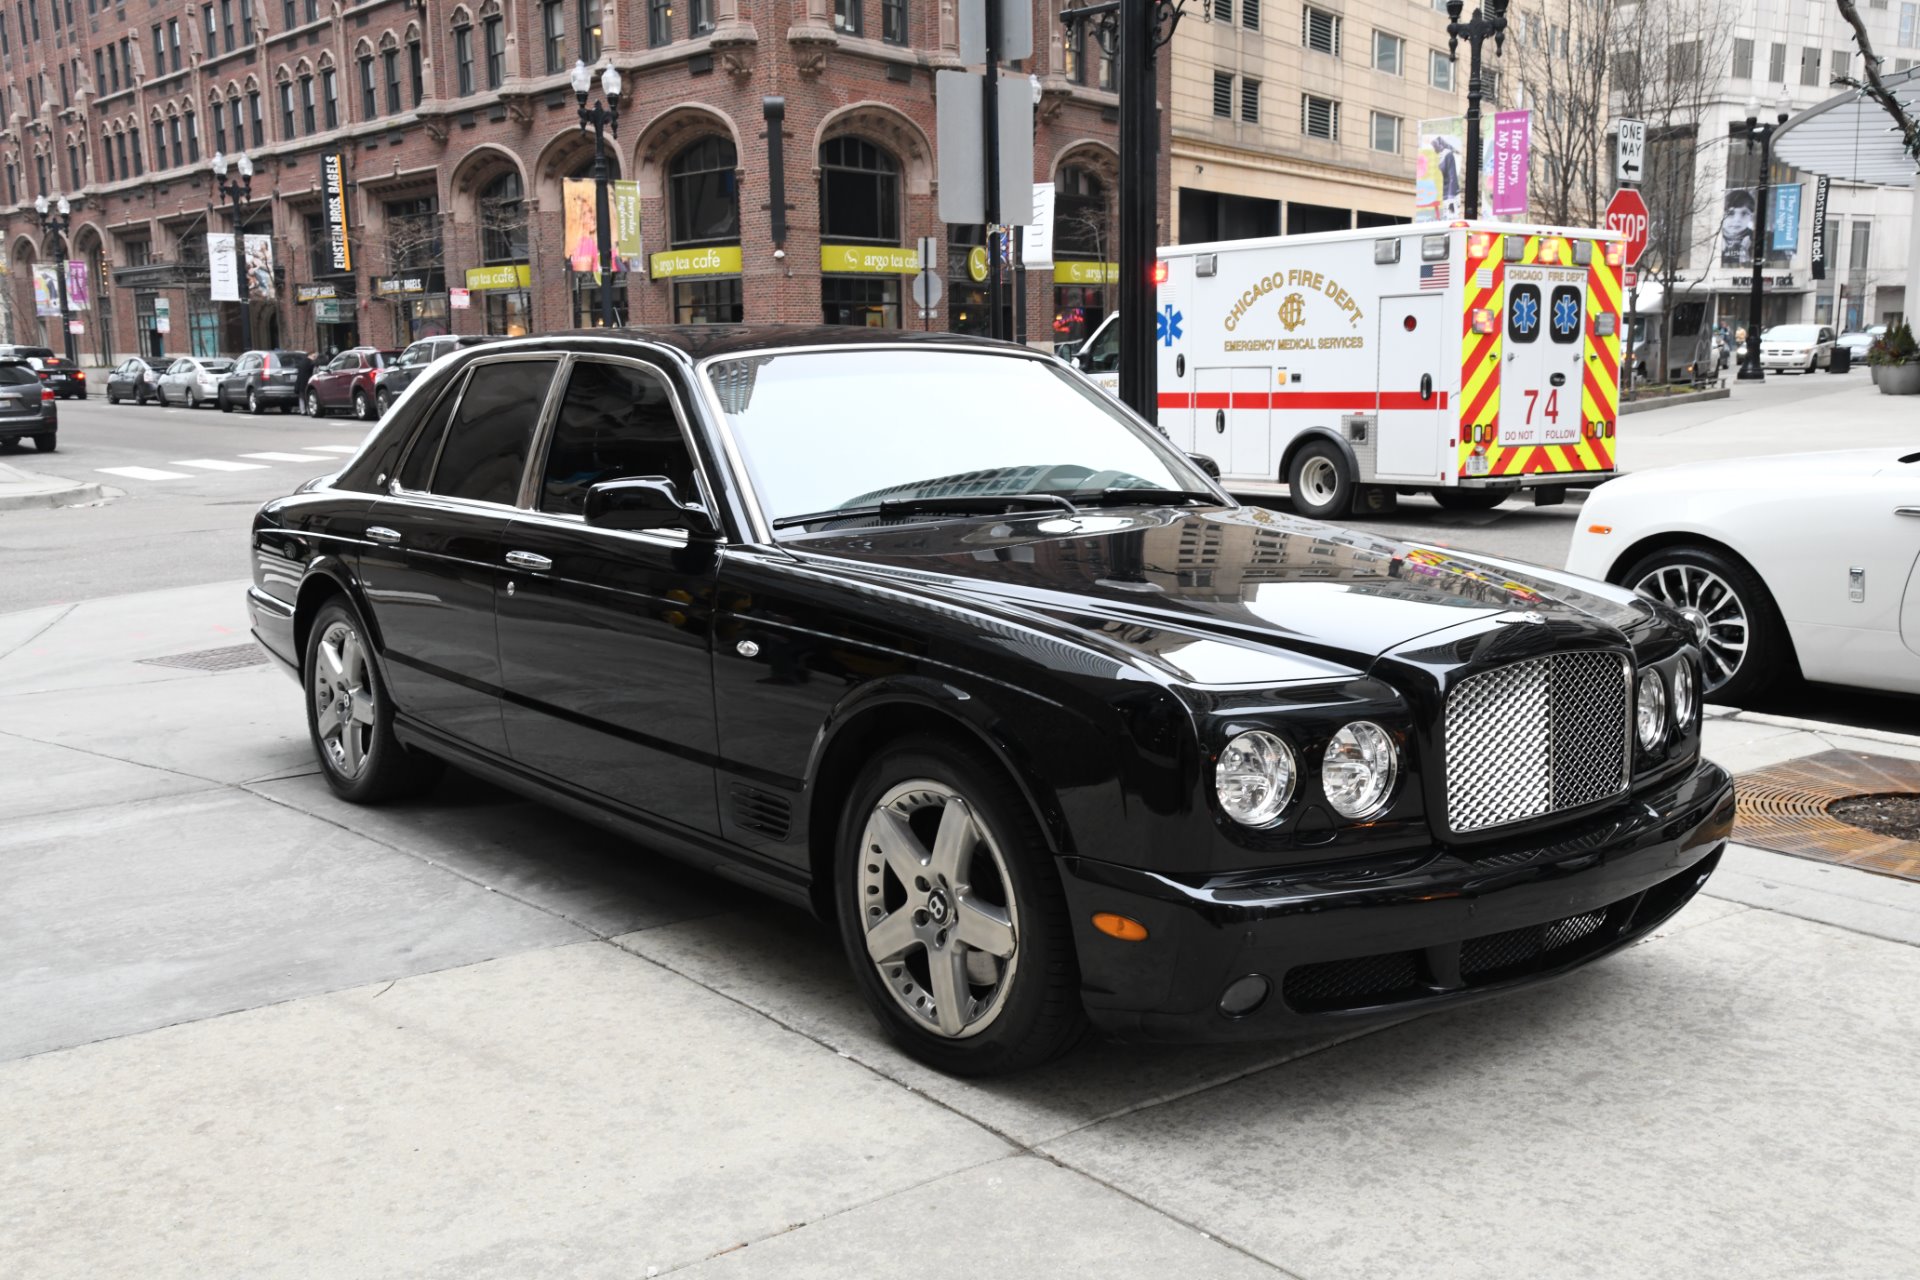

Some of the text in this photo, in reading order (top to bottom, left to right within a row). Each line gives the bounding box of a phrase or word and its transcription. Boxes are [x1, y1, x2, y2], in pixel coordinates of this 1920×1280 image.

[1511, 129, 1522, 151] Her
[1621, 124, 1642, 141] ONE
[1621, 142, 1642, 157] WAY
[1496, 130, 1509, 195] My Dreams
[1508, 153, 1522, 186] Story,
[325, 156, 340, 194] BAGELS
[627, 195, 637, 236] Everyday
[1608, 212, 1646, 242] STOP
[331, 225, 346, 269] EINSTEIN
[1812, 236, 1823, 262] rack
[676, 256, 690, 270] tea
[692, 249, 721, 268] café
[864, 254, 889, 271] argo
[891, 254, 903, 267] tea
[493, 267, 514, 284] café
[1508, 270, 1587, 283] CHICAGO FIRE DEPT.
[1776, 272, 1794, 286] rack
[1224, 271, 1284, 332] CHICAGO
[1288, 269, 1325, 291] FIRE
[1324, 279, 1363, 329] DEPT.
[1224, 336, 1364, 352] EMERGENCY MEDICAL SERVICES
[1504, 429, 1576, 441] DO NOT FOLLOW
